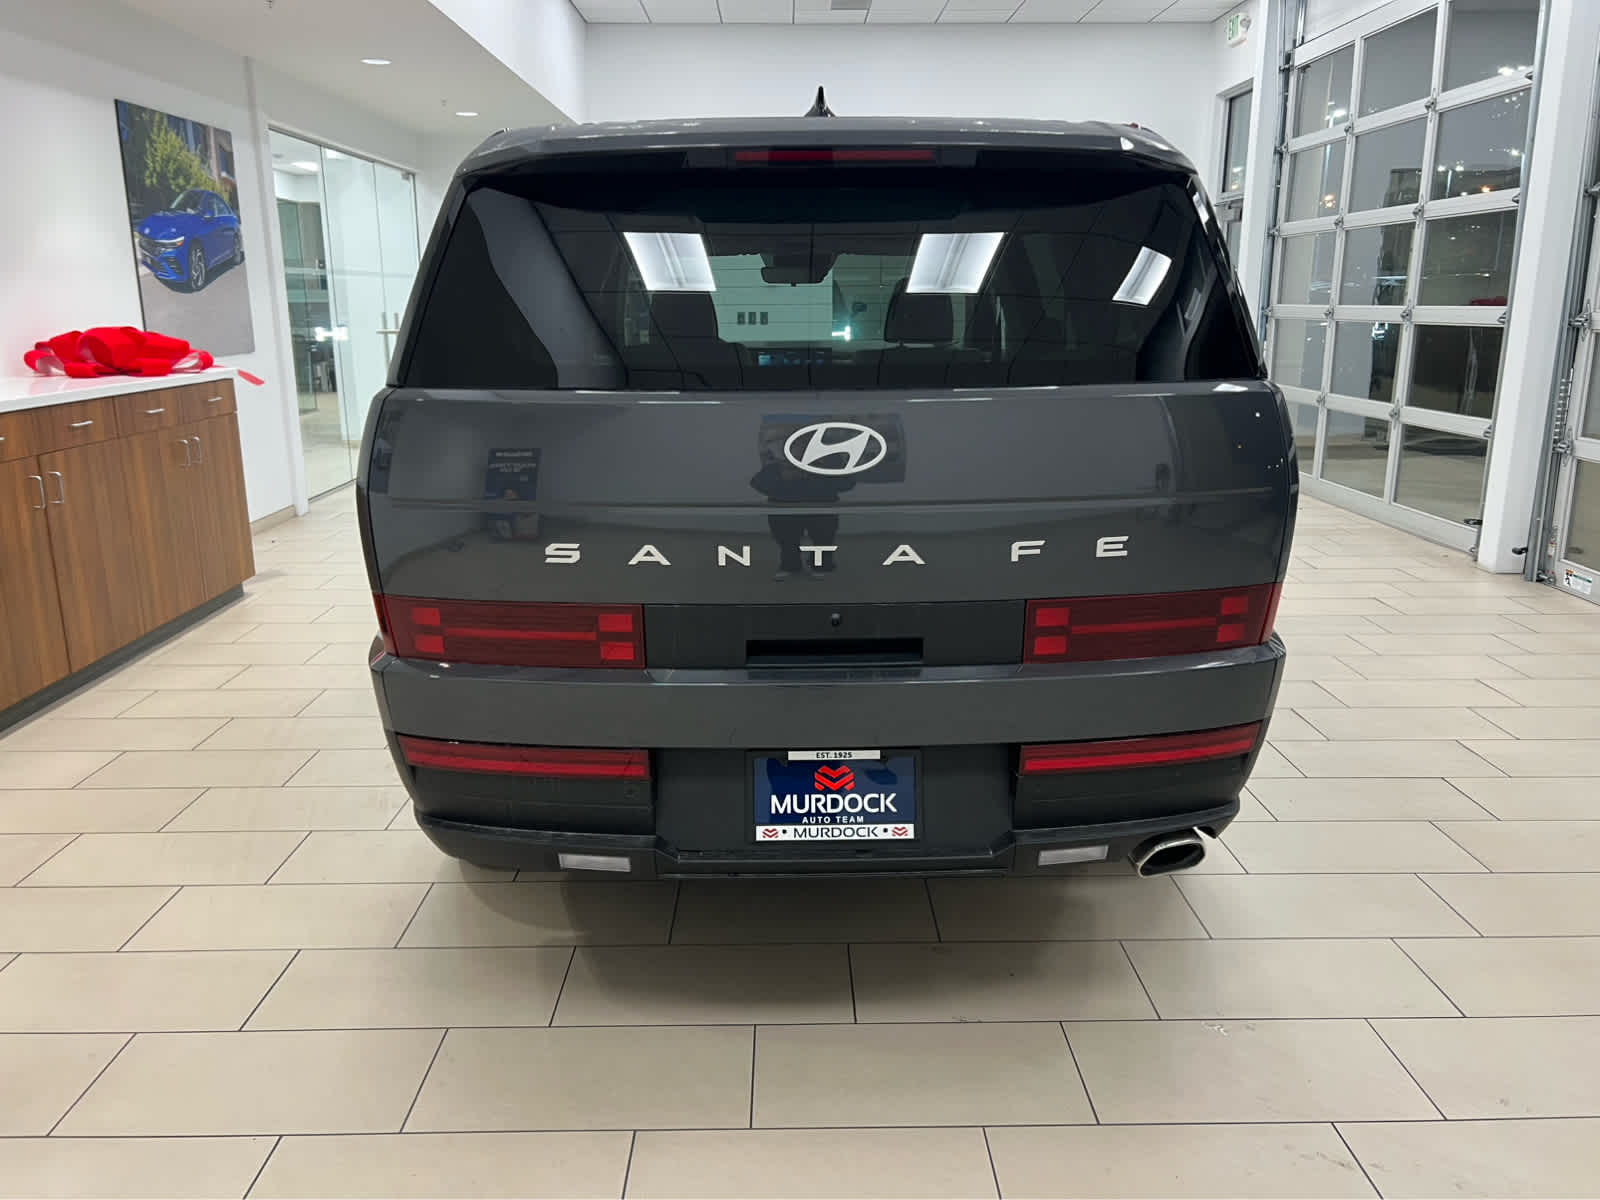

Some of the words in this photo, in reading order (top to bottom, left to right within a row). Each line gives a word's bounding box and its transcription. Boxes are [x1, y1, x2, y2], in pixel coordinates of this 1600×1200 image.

[544, 543, 926, 567] SANTA
[1010, 535, 1129, 562] FE
[833, 751, 853, 759] 1925
[770, 792, 898, 814] MURDOCK
[801, 815, 831, 824] AUTO
[836, 815, 865, 824] TEAM
[793, 826, 879, 839] MURDOCK
